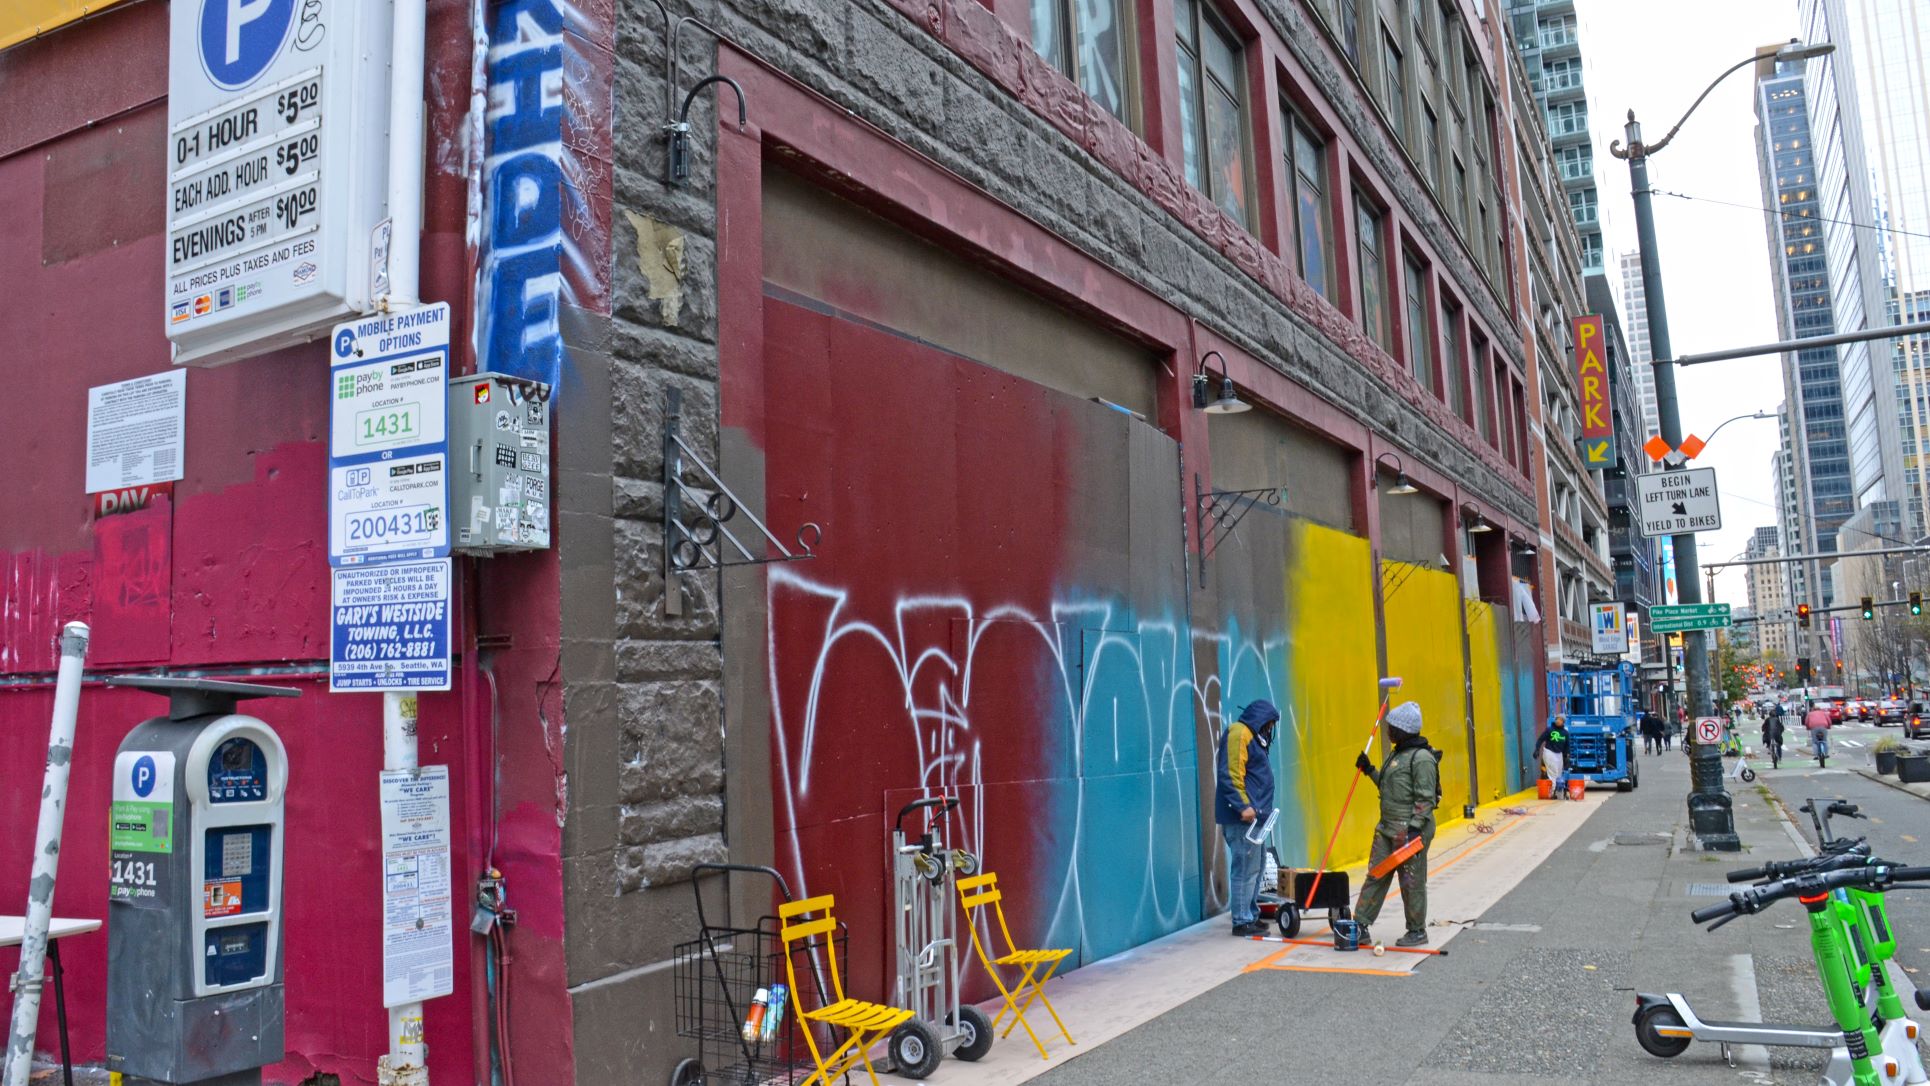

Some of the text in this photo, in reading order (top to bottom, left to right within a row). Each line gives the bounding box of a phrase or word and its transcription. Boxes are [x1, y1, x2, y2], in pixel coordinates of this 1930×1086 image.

[177, 131, 200, 164] 0-1
[208, 108, 259, 152] HOUR
[175, 180, 203, 213] EACH
[207, 171, 231, 201] ADD.
[236, 156, 268, 189] HOUR
[173, 215, 246, 265] EVENINGS
[248, 206, 271, 223] AFTER
[250, 223, 268, 238] 5 PM
[173, 240, 315, 296] ALL PRICES PLUS TAXES AND FEES
[357, 308, 445, 338] MOBILE PAYMENT
[379, 331, 421, 352] OPTIONS
[356, 369, 384, 385] payby
[390, 376, 440, 390] PAYBYPHONE.COM
[1579, 323, 1606, 429] PARK
[356, 381, 384, 397] phone
[372, 398, 399, 408] LOCATION
[364, 411, 412, 439] 1431
[381, 451, 393, 460] OR
[390, 480, 439, 492] CALLTOPARK.COM
[1661, 475, 1691, 488] BEGIN
[338, 486, 378, 501] CallToPark
[1645, 486, 1711, 503] LEFT TURN LANE
[371, 500, 399, 509] LOCATION
[350, 511, 426, 540] 200431
[1646, 515, 1716, 531] YIELD TO BIKES
[338, 565, 444, 580] UNAUTHORIZED OR IMPROPERLY
[346, 574, 435, 587] PARKED VEHCLES WILL BE
[343, 587, 382, 596] IMPOUNDED
[393, 583, 417, 592] HOURS
[424, 582, 438, 590] DAY
[353, 594, 382, 603] OWNER'S
[383, 593, 399, 601] RISK
[407, 591, 439, 600] EXPENSE
[336, 602, 445, 625] GARY'S WESTSIDE
[348, 623, 433, 642] TOWING, L.L.C.
[345, 641, 436, 660] (206) 762-8881
[338, 664, 355, 672] 5939
[357, 663, 368, 671] 4th
[370, 663, 383, 671] Ave
[401, 661, 429, 670] Seattle,
[431, 661, 444, 669] WA
[336, 676, 444, 687] JUMP STARTS UNLOCKS TIRE SERVICE
[112, 860, 157, 886] 1431
[117, 886, 155, 897] paybyphone
